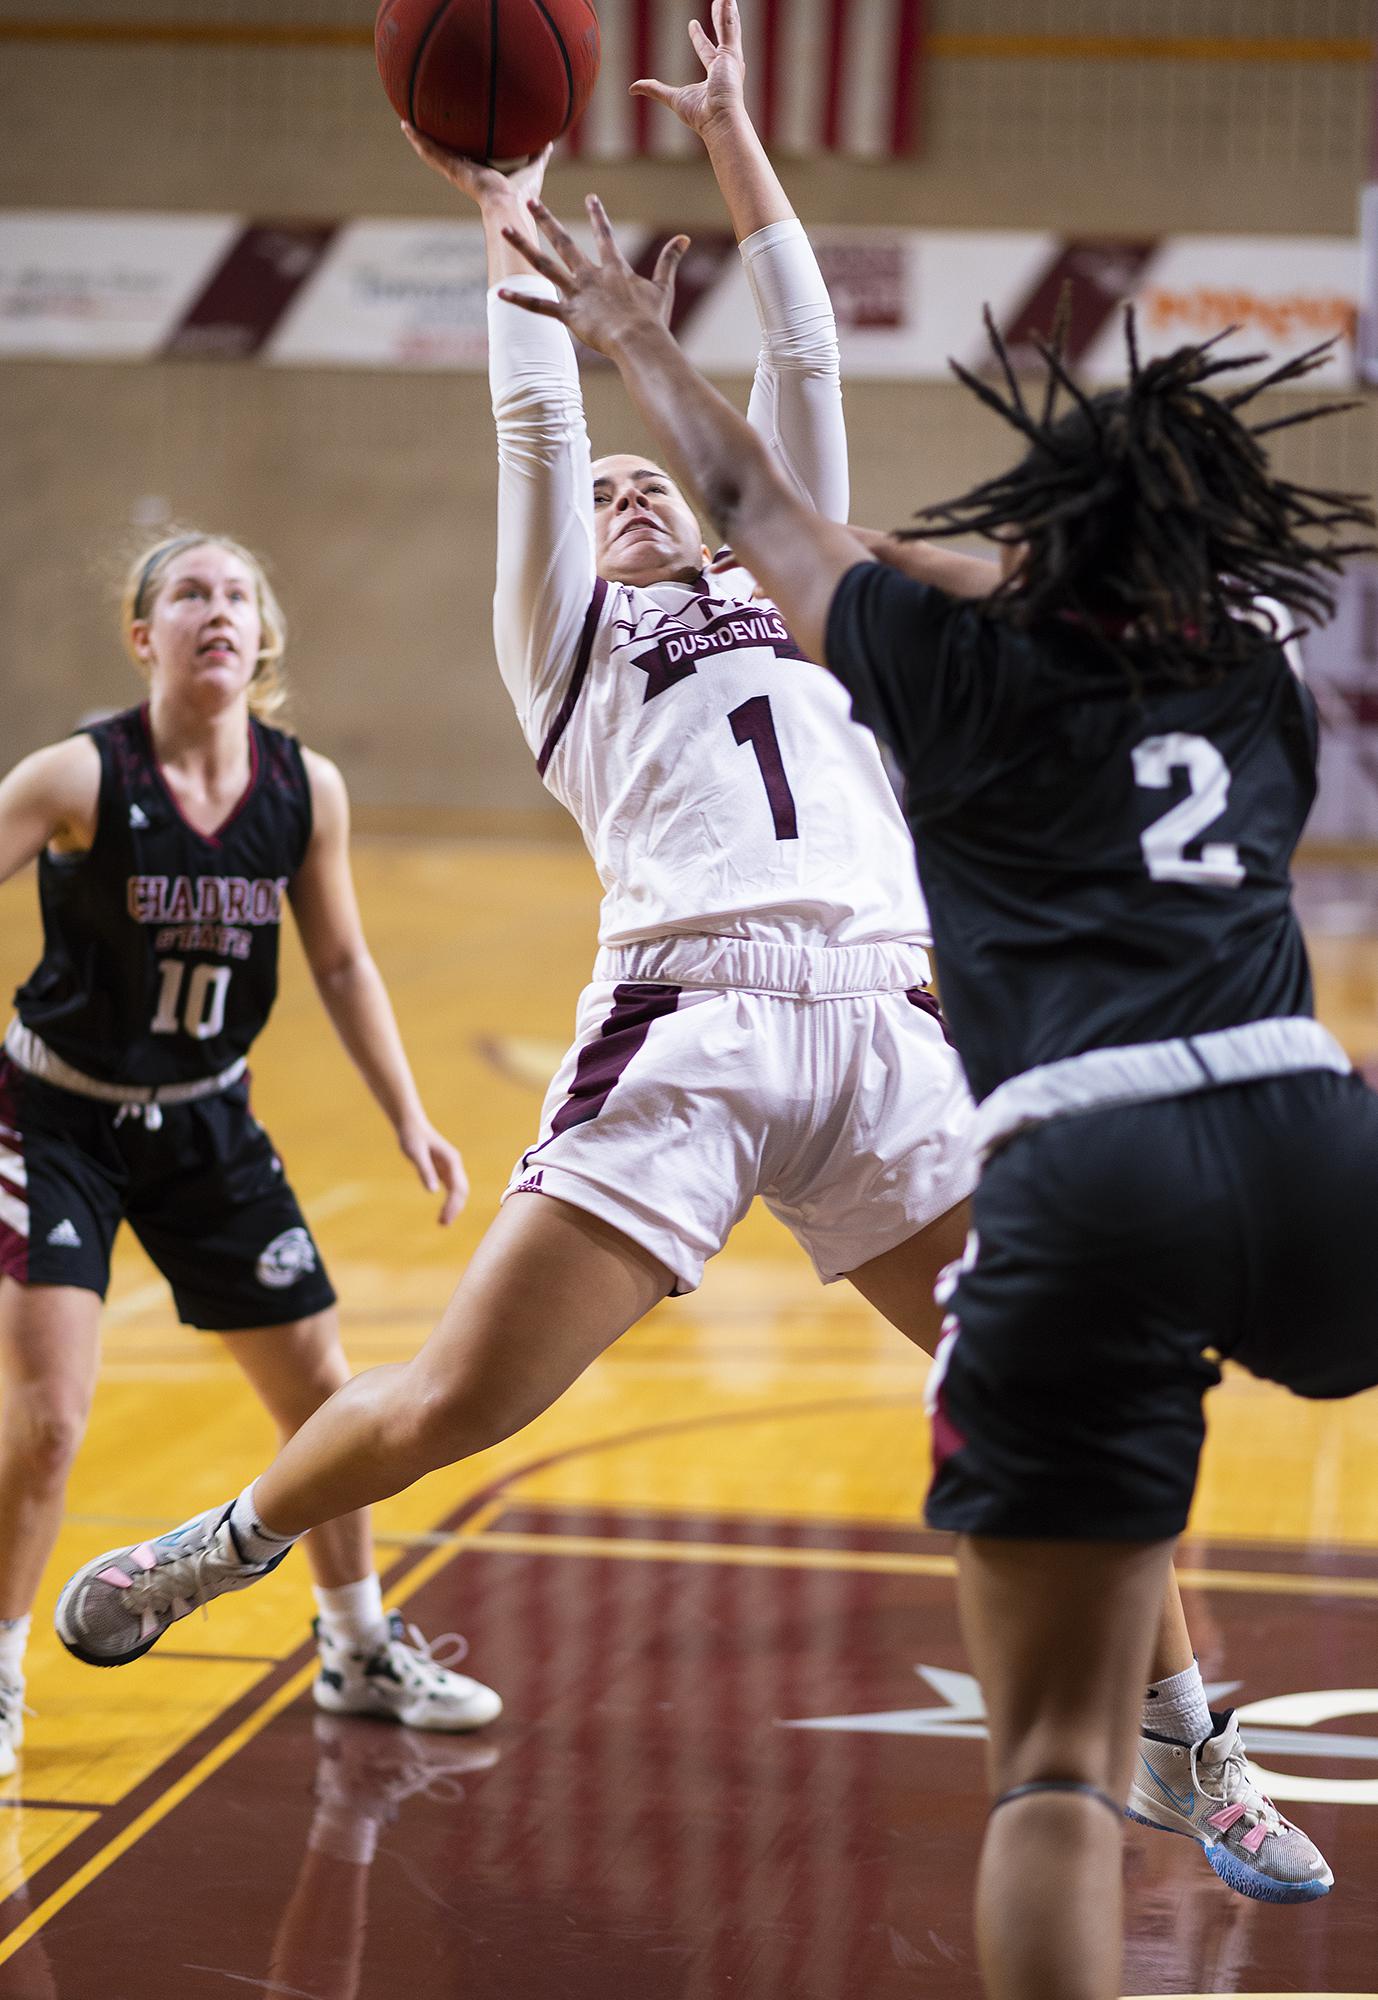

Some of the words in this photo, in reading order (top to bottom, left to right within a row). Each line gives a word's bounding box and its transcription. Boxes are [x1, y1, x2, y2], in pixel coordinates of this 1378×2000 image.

[665, 617, 788, 663] DUSTDEVILS
[727, 695, 798, 840] 1
[1131, 731, 1246, 888] 2
[151, 959, 232, 1040] 10
